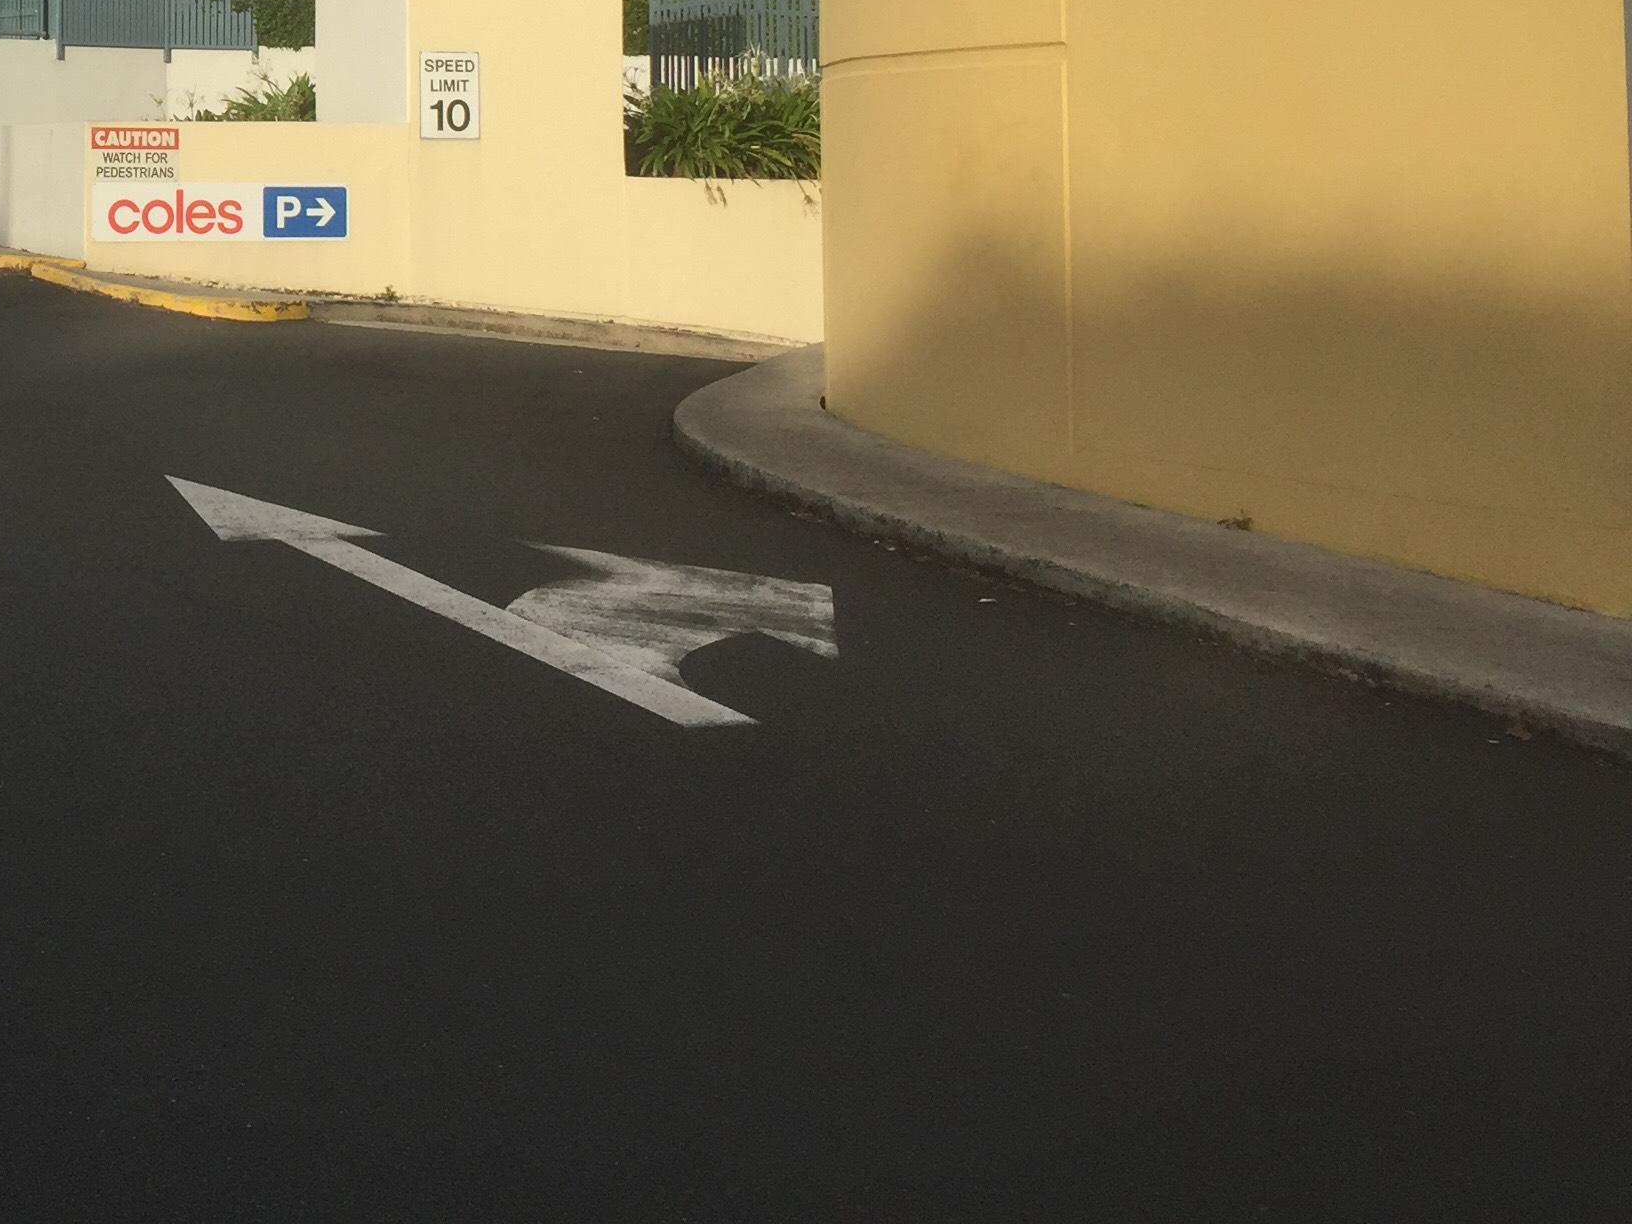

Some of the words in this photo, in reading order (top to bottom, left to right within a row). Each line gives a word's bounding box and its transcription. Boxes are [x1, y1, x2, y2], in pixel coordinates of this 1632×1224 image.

[424, 59, 475, 72] SPEED
[430, 79, 469, 92] LIMIT
[430, 99, 471, 132] 10
[94, 130, 177, 147] CAUTION
[102, 152, 140, 164] WATCH
[145, 153, 168, 164] FOR
[96, 166, 174, 178] PEDESTRIANS
[108, 189, 243, 234] coles
[276, 195, 302, 229] P
